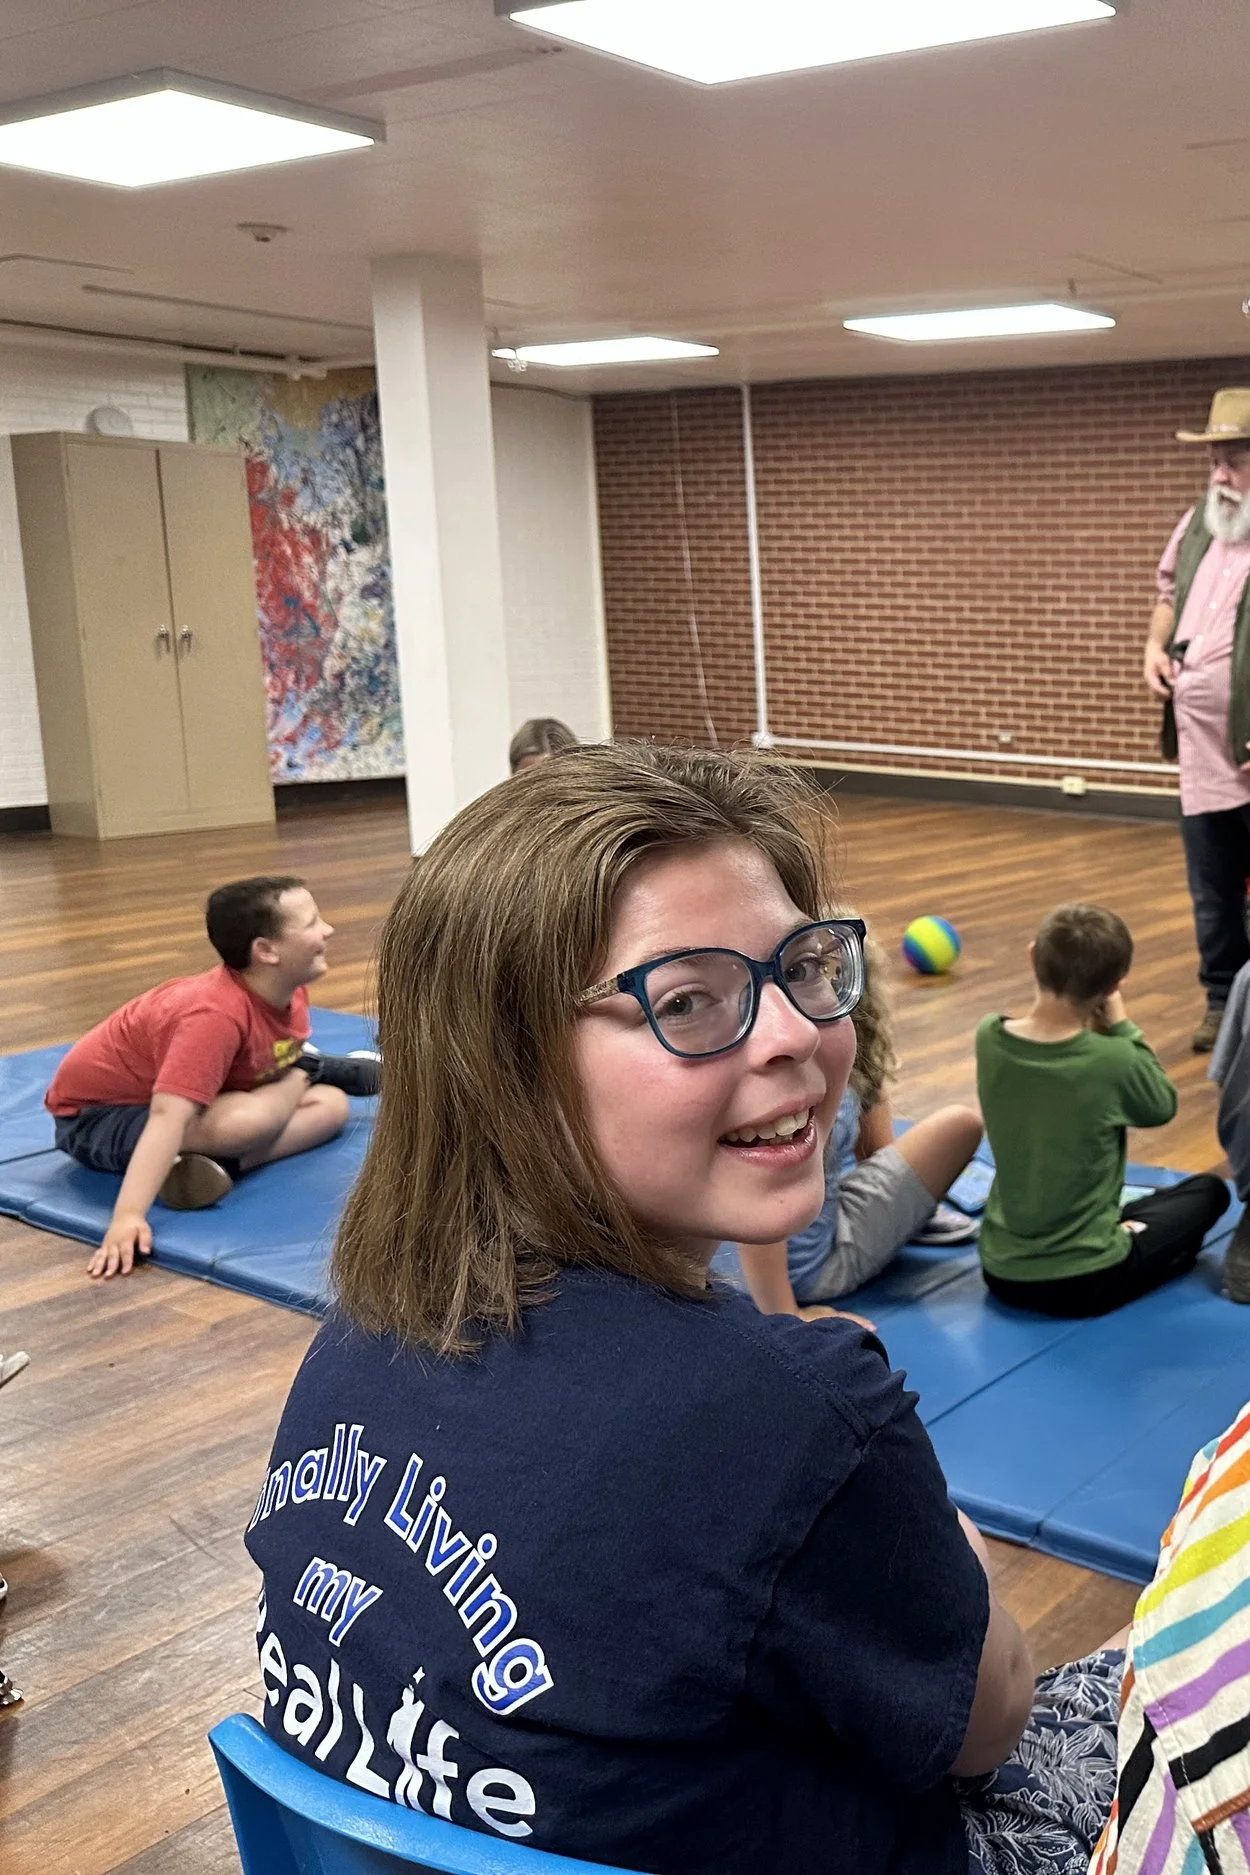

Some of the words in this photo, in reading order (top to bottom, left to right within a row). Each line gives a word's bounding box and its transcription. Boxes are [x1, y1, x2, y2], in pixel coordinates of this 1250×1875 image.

[247, 1423, 387, 1532] inally
[384, 1453, 554, 1716] Living
[293, 1556, 383, 1647] my
[256, 1587, 344, 1762] eal
